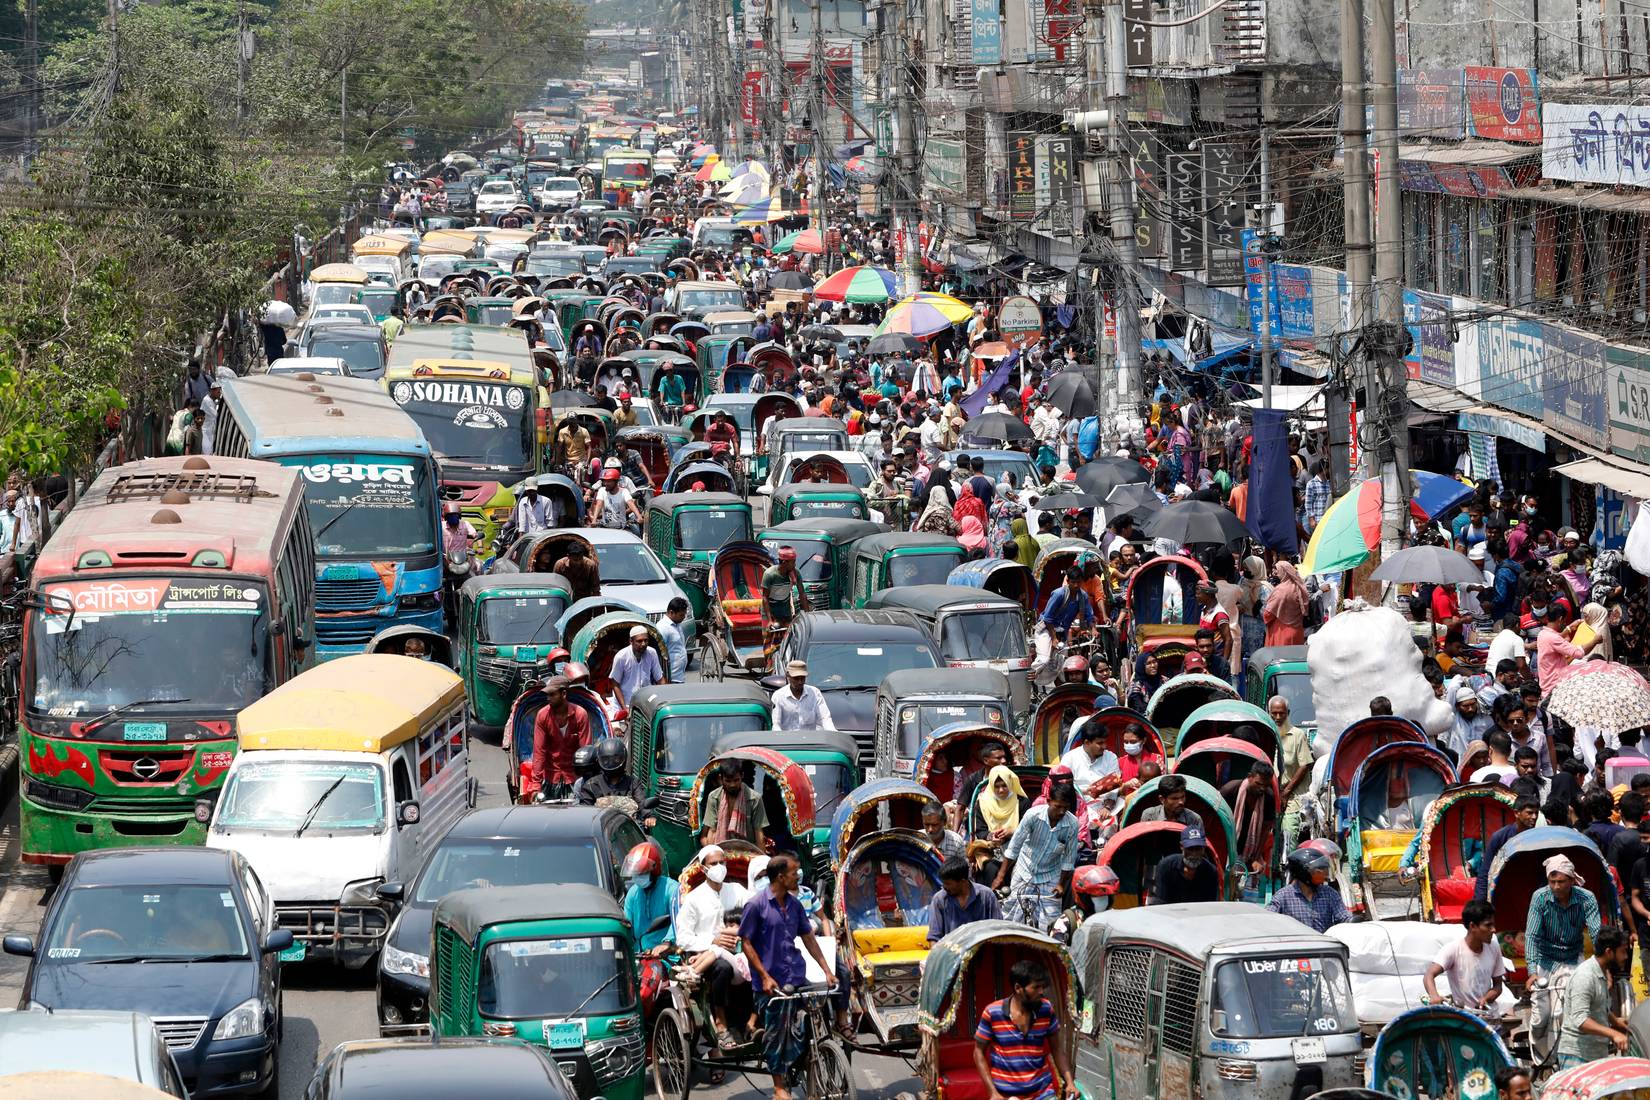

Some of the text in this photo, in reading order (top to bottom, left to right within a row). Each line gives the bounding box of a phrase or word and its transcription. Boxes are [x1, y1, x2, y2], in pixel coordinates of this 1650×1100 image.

[1175, 160, 1193, 265] SENSE
[1012, 318, 1039, 326] Parking
[413, 381, 505, 407] SOHANA
[75, 583, 242, 609] মৌমিতা ট্রান্সপোর্ট লিঃ
[50, 948, 80, 958] POLICE
[1244, 961, 1277, 974] Uber
